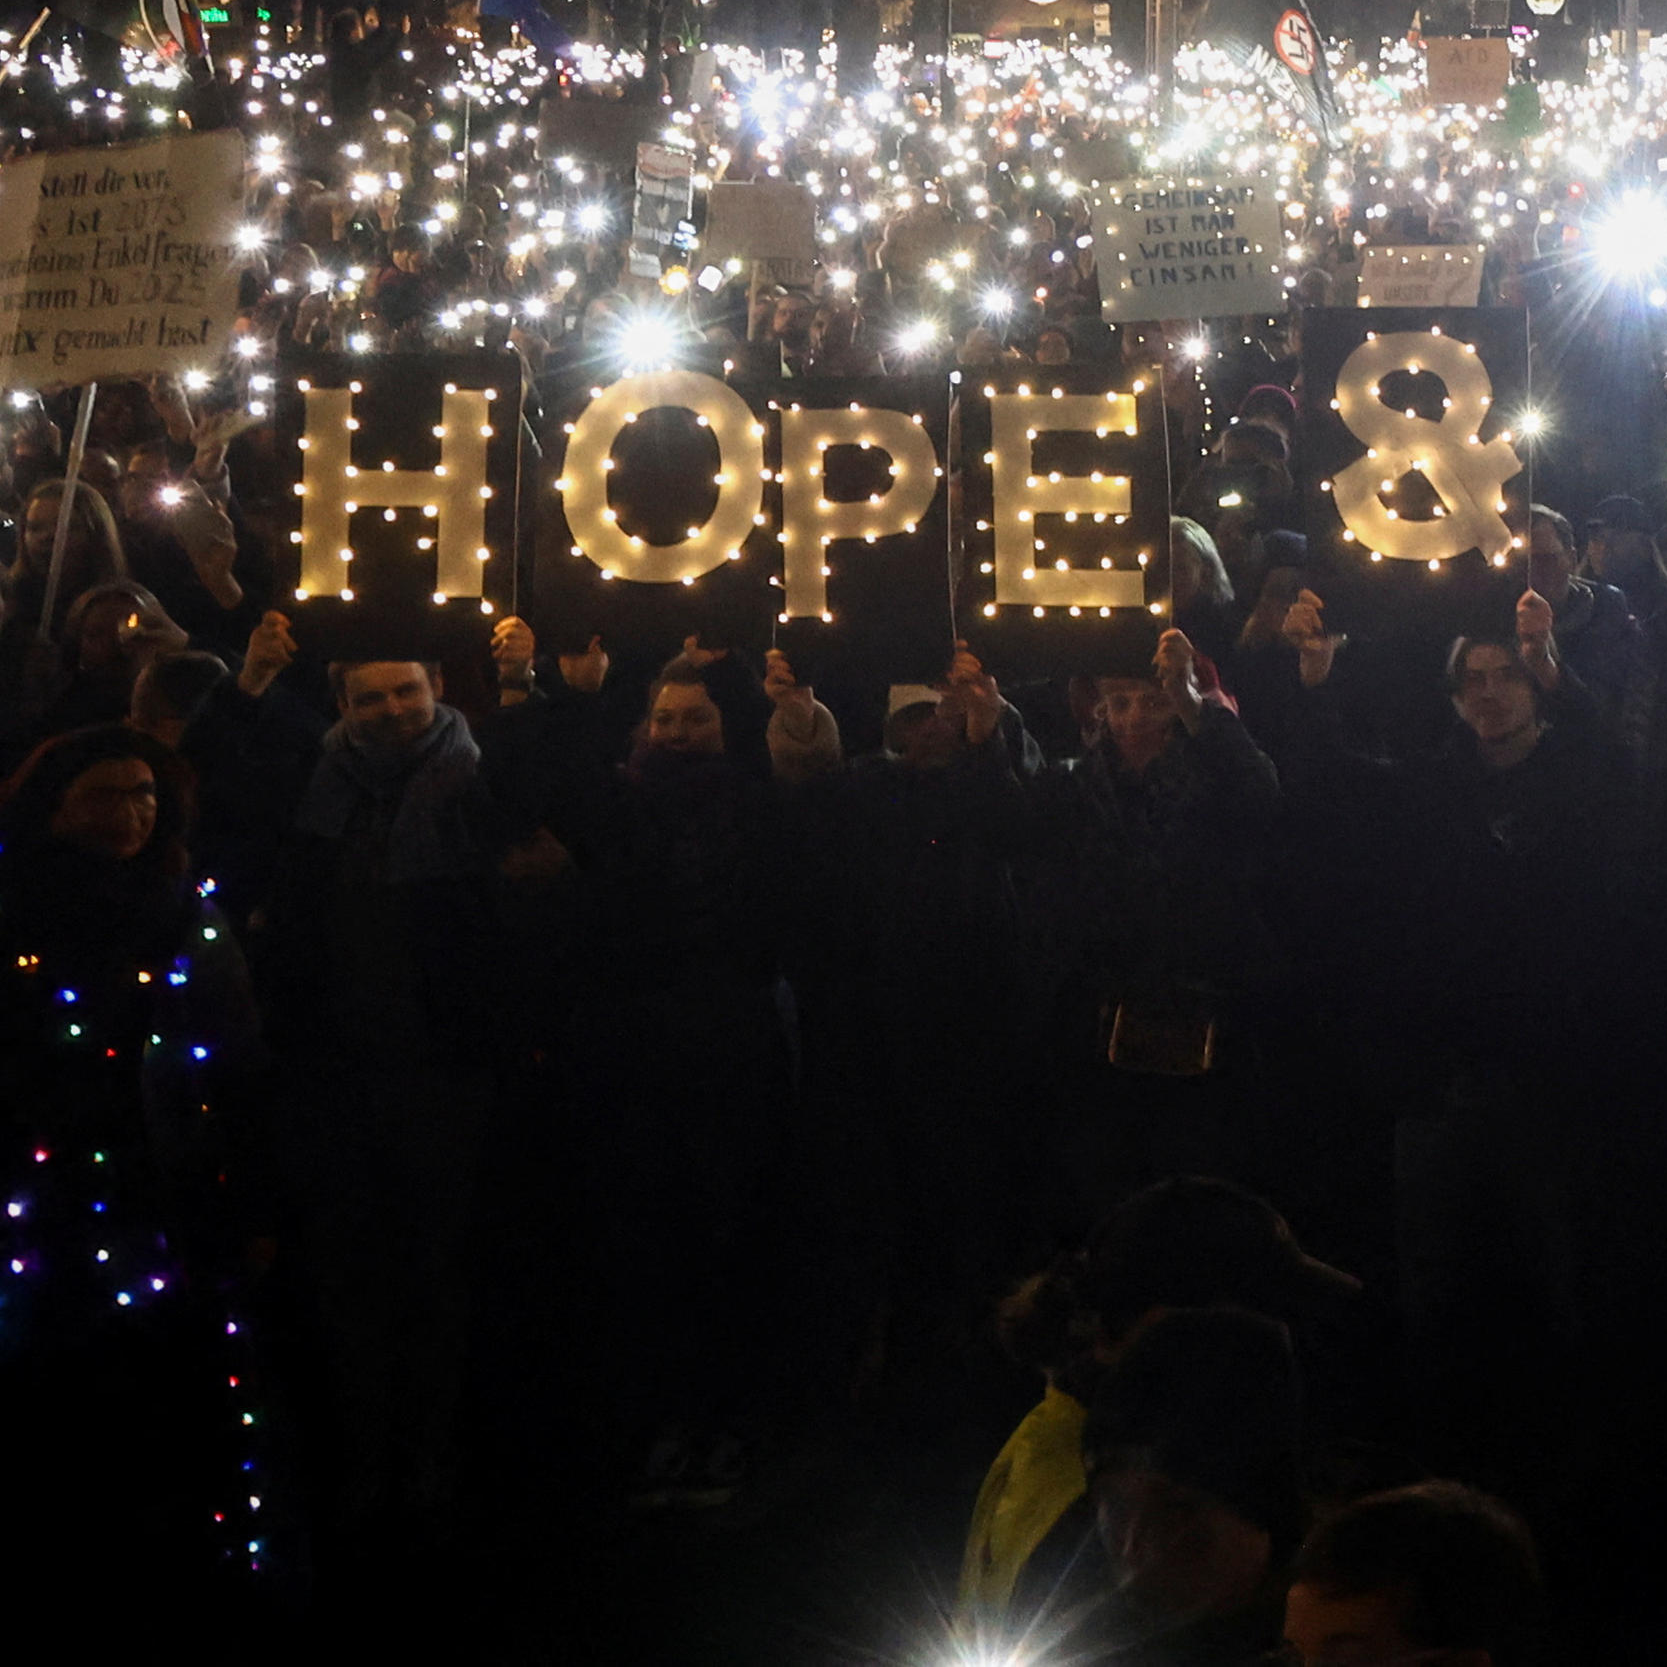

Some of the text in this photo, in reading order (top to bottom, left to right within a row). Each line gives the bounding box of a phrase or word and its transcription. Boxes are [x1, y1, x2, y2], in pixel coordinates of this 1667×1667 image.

[1145, 213, 1237, 236] IST MAN
[1138, 236, 1252, 261] WENIGER
[293, 369, 1156, 621] HOPE
[1327, 327, 1526, 567] &
